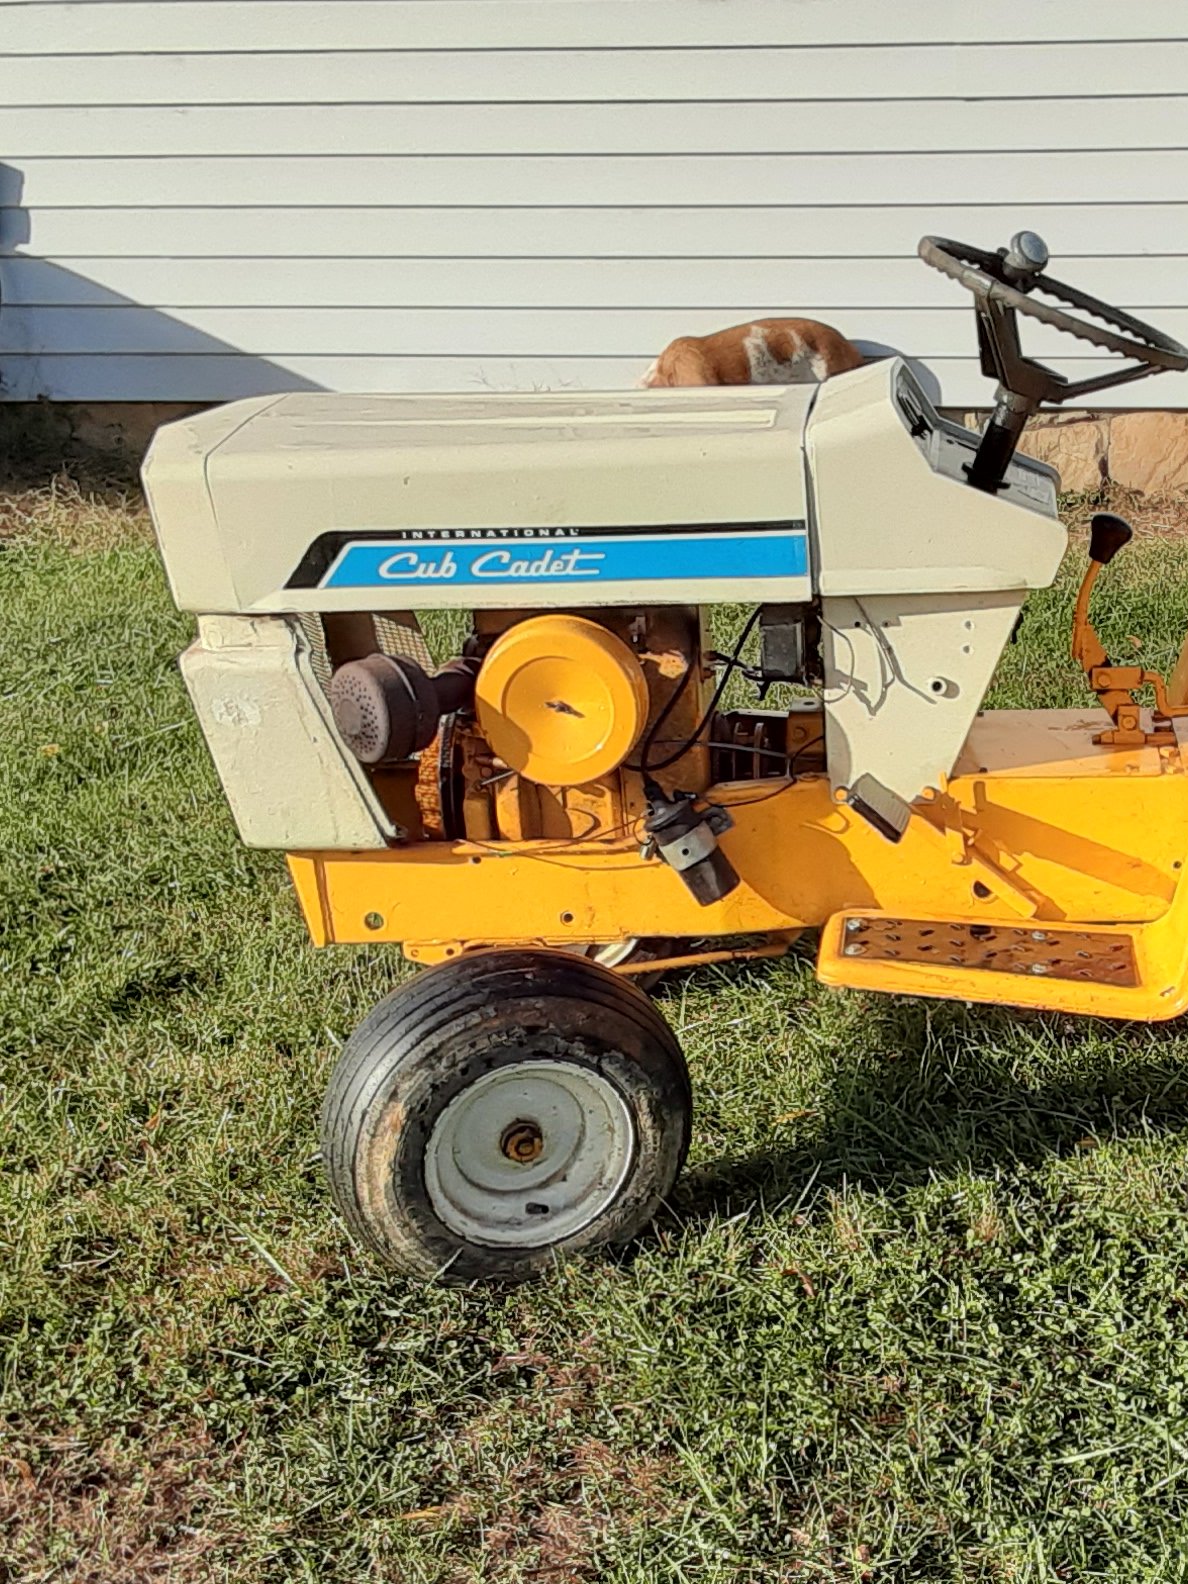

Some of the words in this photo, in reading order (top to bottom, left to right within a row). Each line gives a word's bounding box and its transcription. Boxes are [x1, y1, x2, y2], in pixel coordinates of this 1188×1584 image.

[401, 528, 578, 539] INTERNATIONAL
[378, 551, 457, 579] Cub
[471, 548, 606, 578] Cadet
